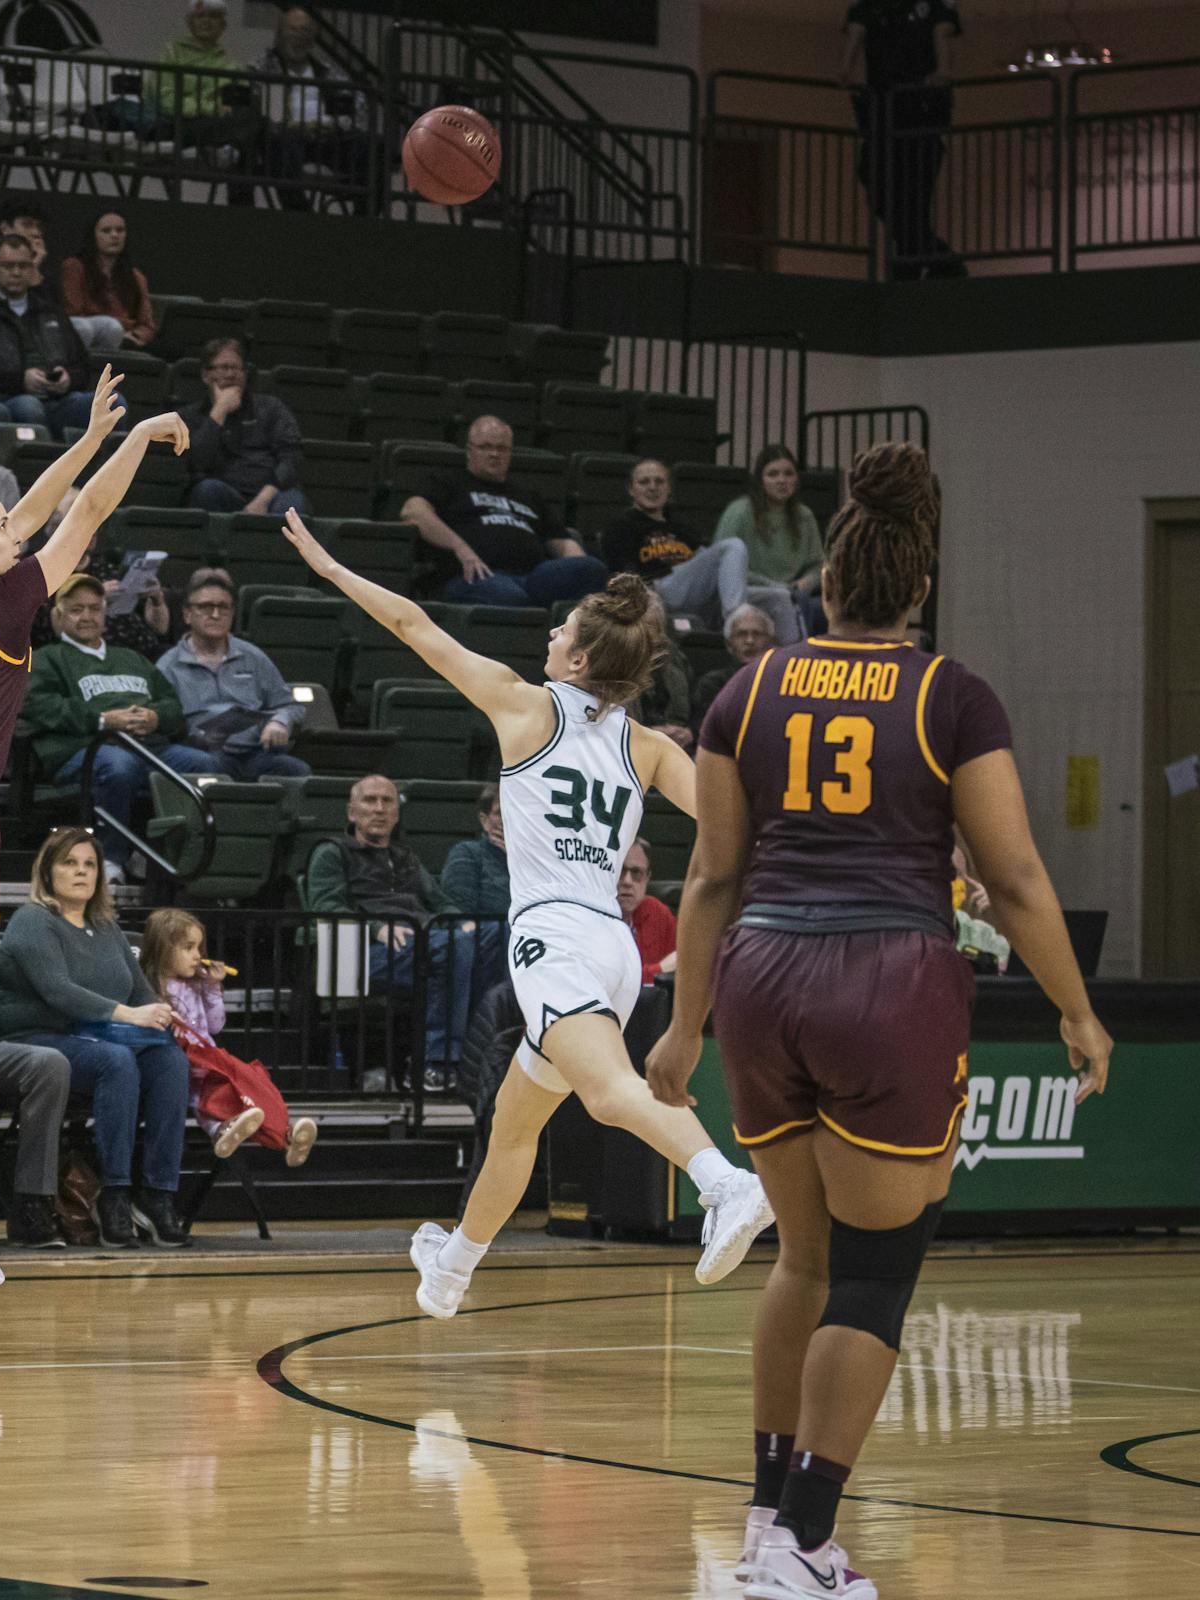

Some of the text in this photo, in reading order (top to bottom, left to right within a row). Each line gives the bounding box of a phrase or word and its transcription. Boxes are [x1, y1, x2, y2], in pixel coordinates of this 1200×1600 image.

[779, 656, 900, 702] HUBBARD
[782, 711, 876, 816] 13
[541, 765, 632, 852] 34
[513, 935, 546, 969] GB
